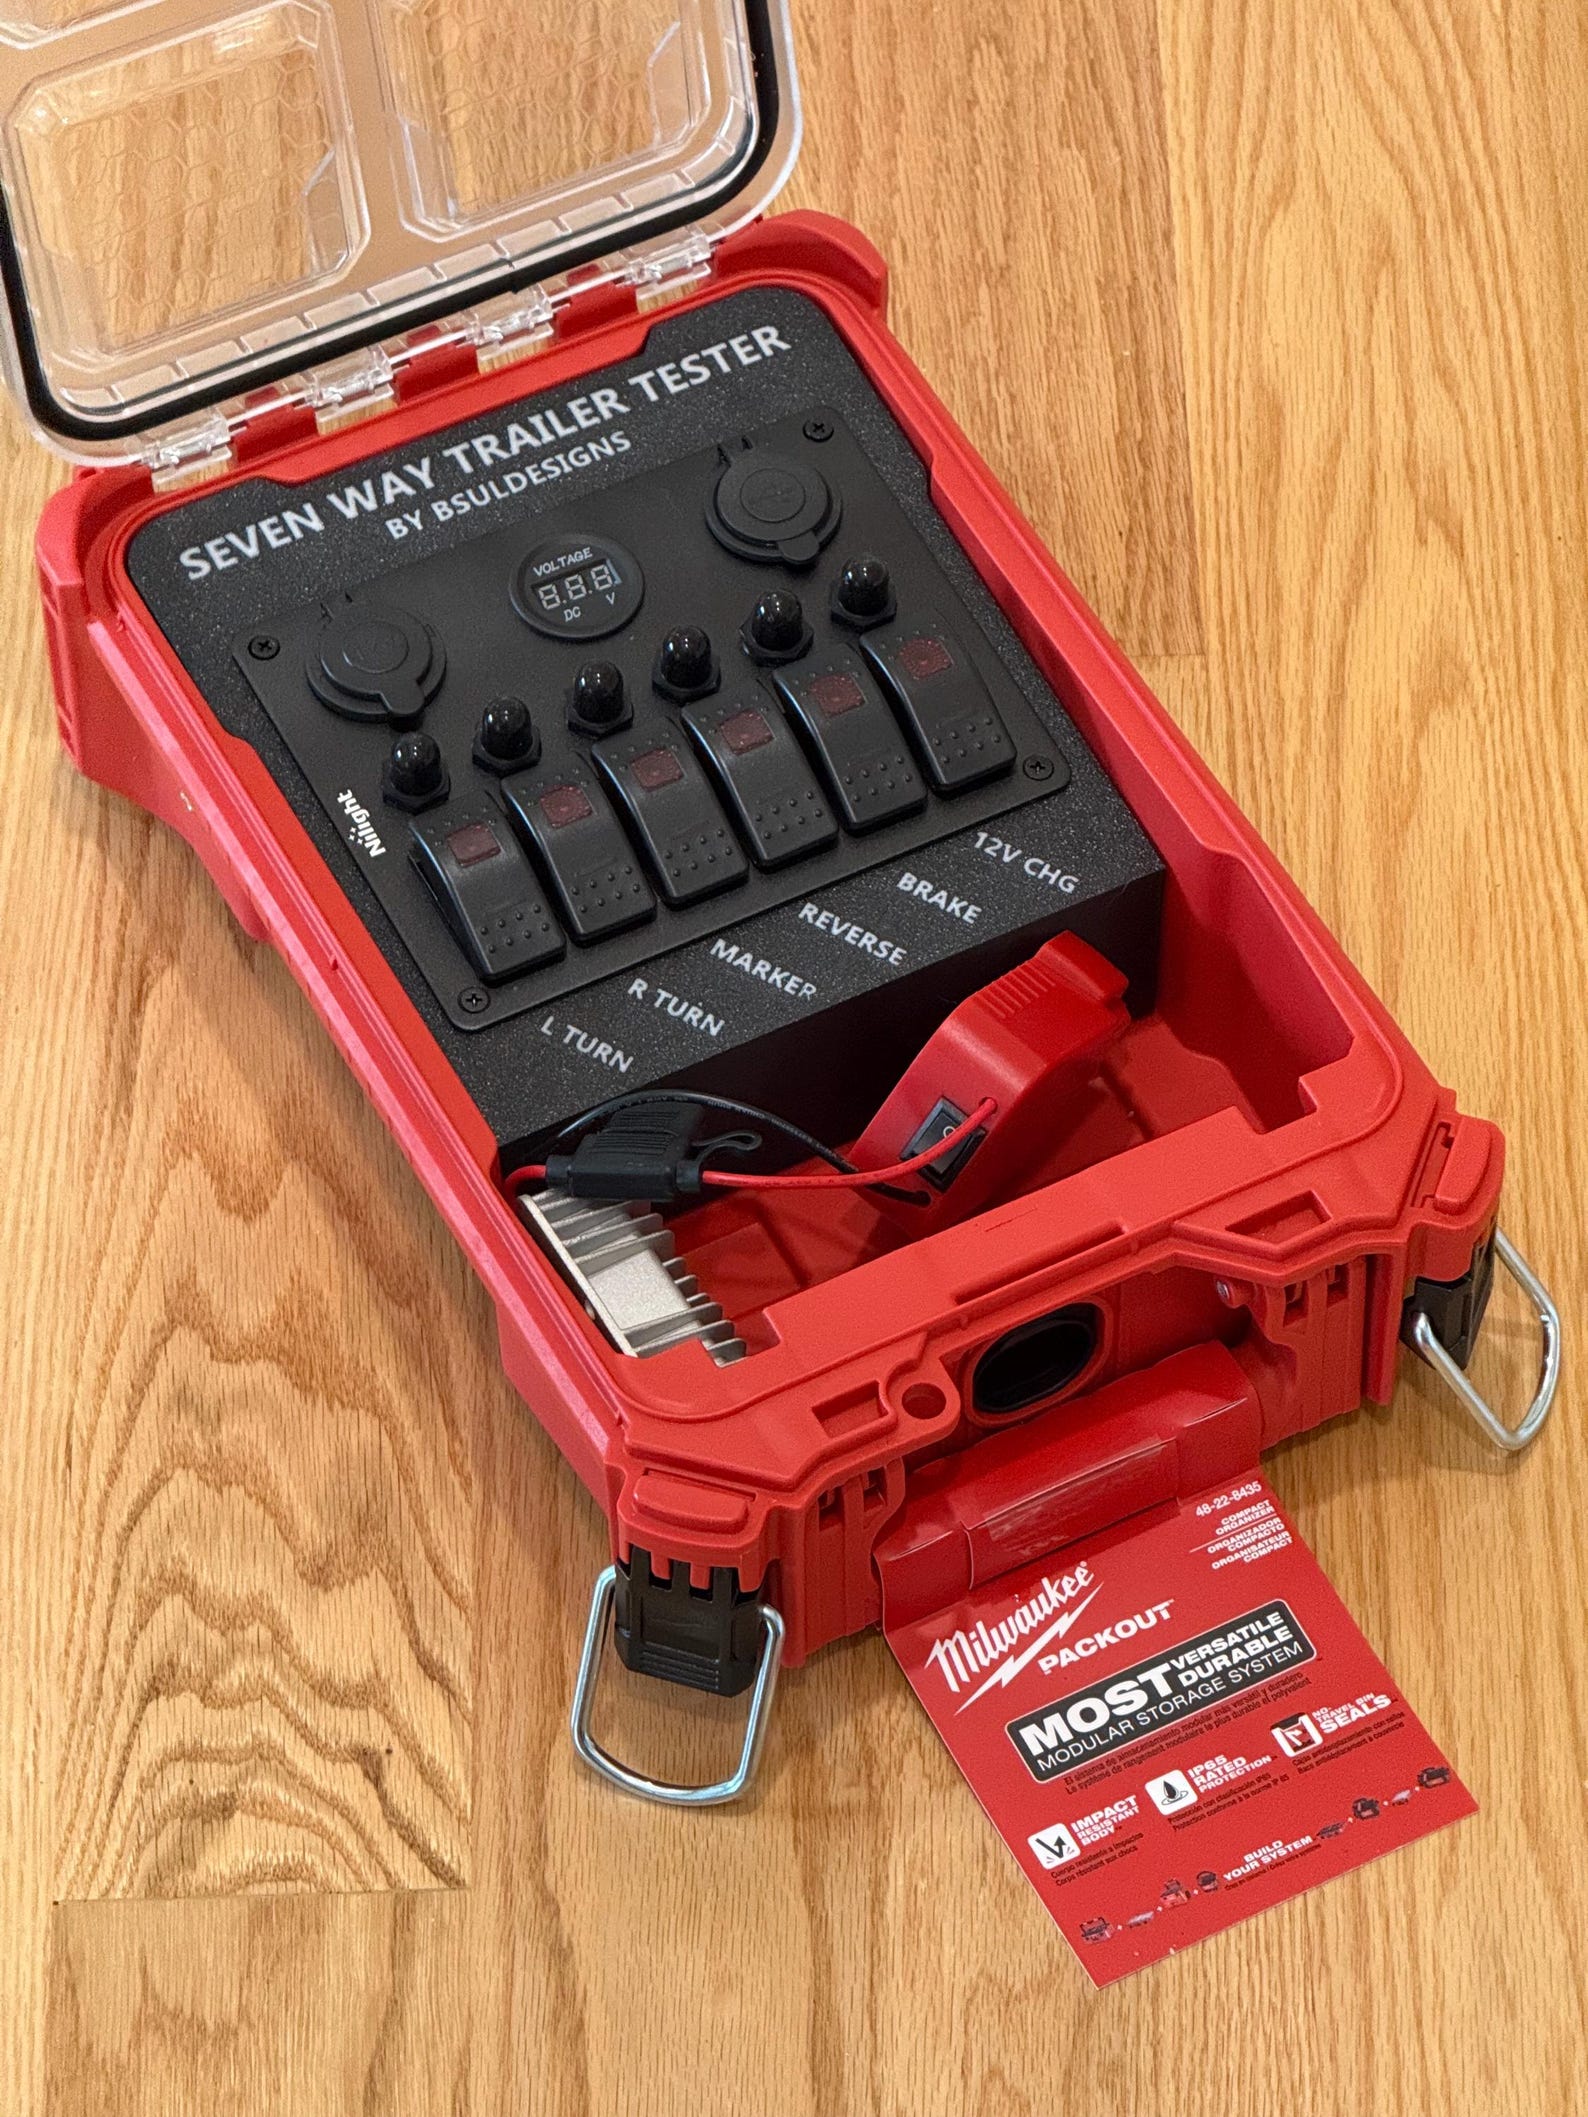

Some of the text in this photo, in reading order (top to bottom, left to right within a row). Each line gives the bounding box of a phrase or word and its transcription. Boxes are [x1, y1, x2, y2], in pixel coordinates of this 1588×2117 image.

[179, 325, 792, 580] SEVEN WAY TRAILER TESTER
[385, 430, 632, 541] BY BSULDESIGNS
[533, 546, 593, 577] VOLTAGE
[563, 605, 581, 622] DC
[605, 591, 616, 606] V
[336, 788, 387, 858] Nilight
[973, 831, 1080, 895] 12V CHG
[896, 871, 983, 925] BRAKE
[798, 902, 908, 966] REVERSE
[709, 938, 818, 1001] MARKER
[627, 977, 726, 1037] R TURN
[540, 1015, 635, 1074] L TURN
[1195, 1480, 1262, 1517] 48-22-8435
[1221, 1499, 1270, 1525] COMPACT
[1207, 1516, 1282, 1554] ORGANIZADOR
[1215, 1505, 1276, 1535] ORGANIZER
[1227, 1522, 1285, 1552] COMPACTO
[1211, 1530, 1291, 1570] ORGANISATEUR
[1243, 1535, 1293, 1563] COMPACT
[923, 1564, 1095, 1693] Milwaukee
[1037, 1600, 1173, 1676] PACKOUT
[1169, 1611, 1285, 1671] VERSATILE
[1177, 1625, 1294, 1687] DURABLE
[1018, 1662, 1173, 1757] MOST
[1036, 1641, 1304, 1773] MODULAR STORAGE SYSTEM
[1316, 1702, 1355, 1722] TRAVEL
[1319, 1693, 1392, 1734] SEALS
[1187, 1754, 1228, 1778] IP65
[1193, 1756, 1247, 1787] RATED
[1198, 1754, 1273, 1793] PROTECTION
[1070, 1794, 1137, 1833] IMPACT
[1076, 1805, 1140, 1840] RESISTANT
[1080, 1825, 1115, 1847] BODY
[1243, 1840, 1284, 1863] BUILD
[1223, 1860, 1260, 1881] YOUR
[1260, 1834, 1314, 1864] SYSTEM
